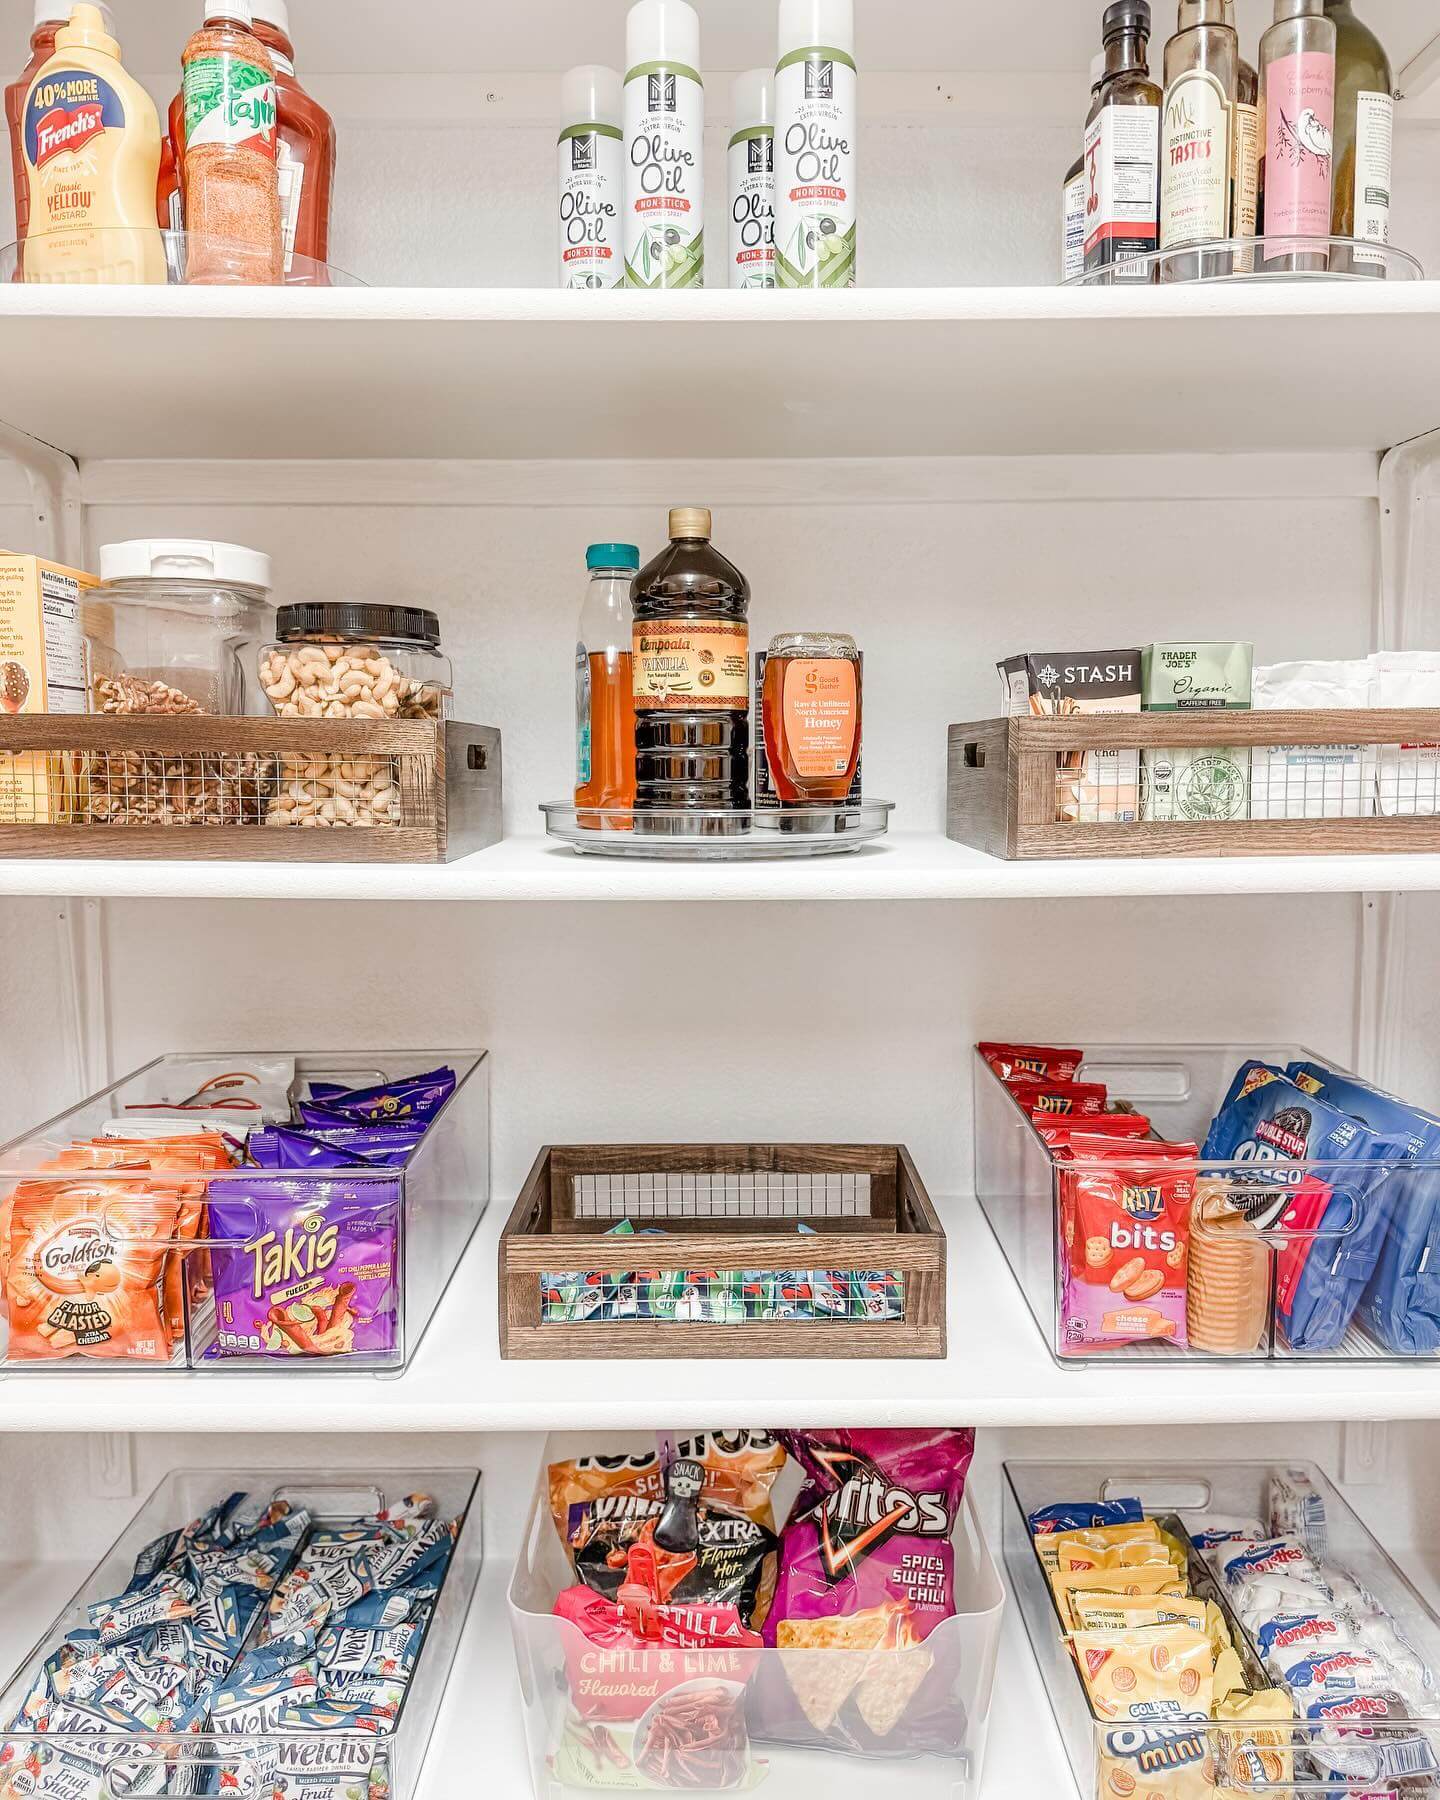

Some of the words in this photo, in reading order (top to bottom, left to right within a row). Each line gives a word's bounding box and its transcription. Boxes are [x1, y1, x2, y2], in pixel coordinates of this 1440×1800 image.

[35, 82, 66, 109] 40%
[67, 79, 97, 97] MORE
[39, 112, 97, 155] French's
[785, 123, 850, 155] Olive
[1169, 128, 1213, 147] DISTINCTIVE
[631, 135, 695, 167] Olive
[796, 151, 841, 182] Oil
[54, 182, 81, 193] Classic
[641, 163, 685, 193] Oil
[47, 191, 91, 213] YELLOW
[560, 191, 617, 220] Olive
[51, 210, 87, 221] MUSTARD
[567, 217, 607, 244] Oil
[41, 570, 64, 586] Nutrition
[64, 577, 78, 590] Facts
[43, 603, 62, 614] Calories
[640, 637, 690, 654] Cempoala
[641, 656, 689, 672] VAINILLA
[1161, 652, 1198, 661] TRADER
[1165, 660, 1191, 669] JOE'S
[1063, 664, 1133, 684] STASH
[1172, 675, 1234, 698] Organic
[794, 700, 809, 709] Raw
[818, 699, 851, 708] Unfiltered
[795, 708, 817, 716] North
[818, 708, 849, 716] American
[1181, 700, 1208, 708] CAFFEINE
[804, 717, 843, 731] Honey
[1256, 1121, 1283, 1143] DOUBLE
[1282, 1131, 1305, 1154] STUF
[1122, 1186, 1166, 1213] RITZ
[1110, 1221, 1176, 1251] bits
[46, 1239, 115, 1269] Goldfish
[244, 1215, 340, 1298] Takis
[285, 1283, 310, 1298] FUEGO
[61, 1300, 100, 1315] FLAVOR
[48, 1310, 110, 1332] BLASTED
[1115, 1315, 1149, 1323] cheese
[77, 1334, 110, 1346] CHEDDAR
[674, 1462, 700, 1480] SNACK
[813, 1470, 949, 1533] ritos
[901, 1554, 944, 1571] SPICY
[892, 1569, 945, 1588] SWEET
[907, 1587, 945, 1603] CHILI
[119, 1606, 165, 1630] Snacks
[127, 1603, 157, 1622] Fruit
[169, 1624, 183, 1648] Fruit
[385, 1631, 397, 1650] Fruit
[393, 1629, 411, 1657] Snacks
[1275, 1619, 1338, 1648] donettes
[580, 1652, 649, 1674] CHILI
[658, 1652, 675, 1673] &
[684, 1650, 742, 1674] LIME
[1312, 1654, 1372, 1684] donettes
[344, 1688, 376, 1701] Fruit
[578, 1679, 660, 1698] Flavored
[1129, 1701, 1181, 1717] GOLDEN
[278, 1741, 372, 1767] Welch's
[1140, 1735, 1202, 1771] mini
[286, 1765, 305, 1773] FAMILY
[17, 1775, 32, 1787] REAL
[54, 1768, 91, 1791] Fruit
[299, 1787, 335, 1800] Fruit
